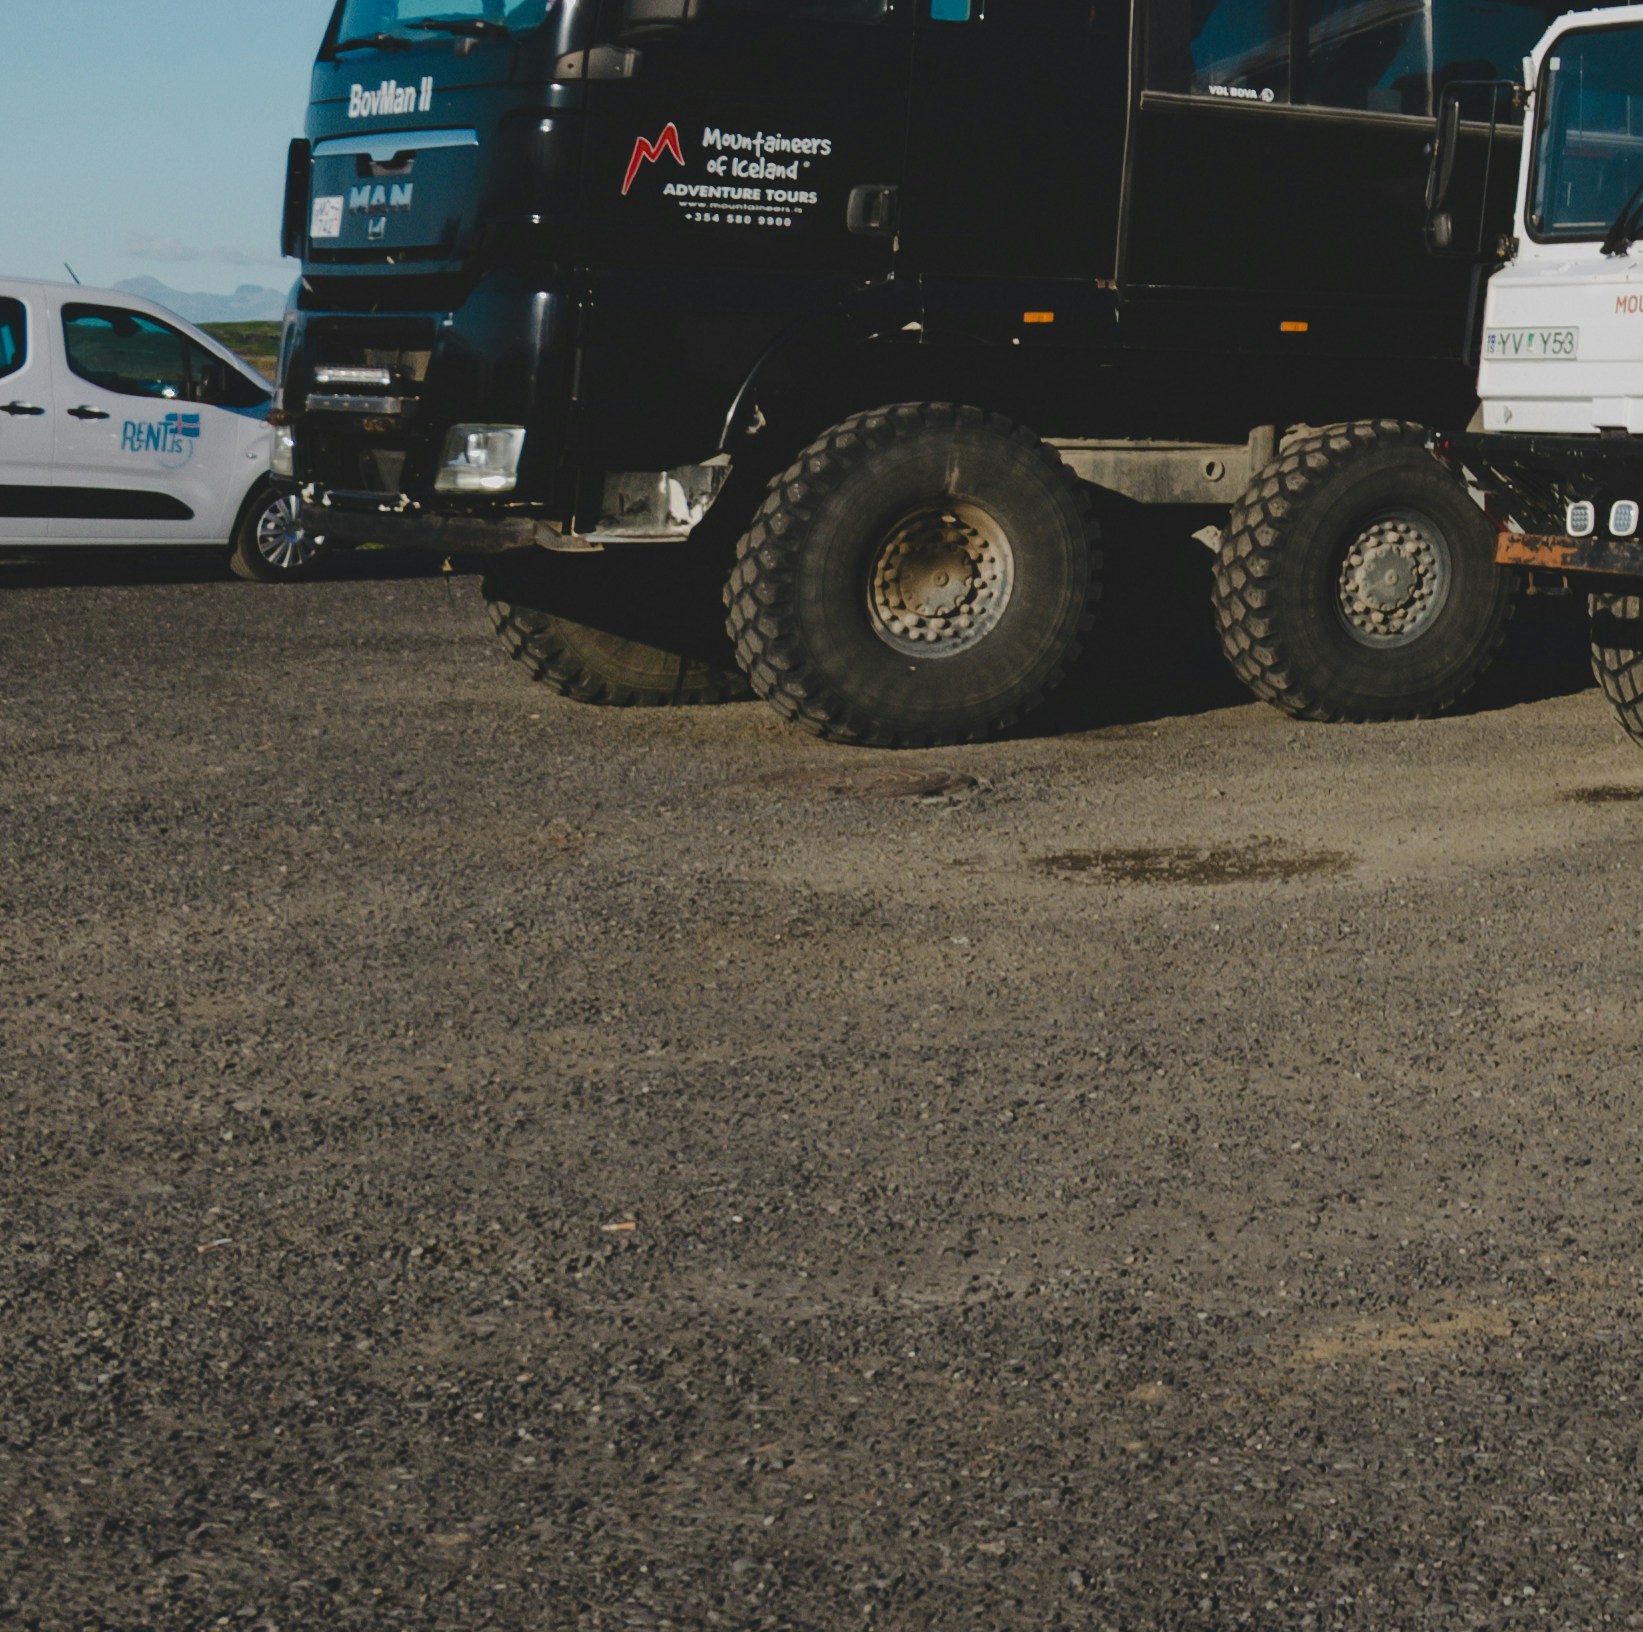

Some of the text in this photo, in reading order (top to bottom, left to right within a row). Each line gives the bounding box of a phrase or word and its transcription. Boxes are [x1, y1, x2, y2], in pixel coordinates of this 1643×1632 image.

[348, 79, 416, 118] BovMan
[702, 127, 832, 158] Mountaineers
[706, 156, 729, 177] of
[350, 183, 414, 214] MAN
[663, 183, 818, 204] ADVENTURE TOURS
[684, 212, 720, 223] +354
[757, 216, 792, 227] 9900
